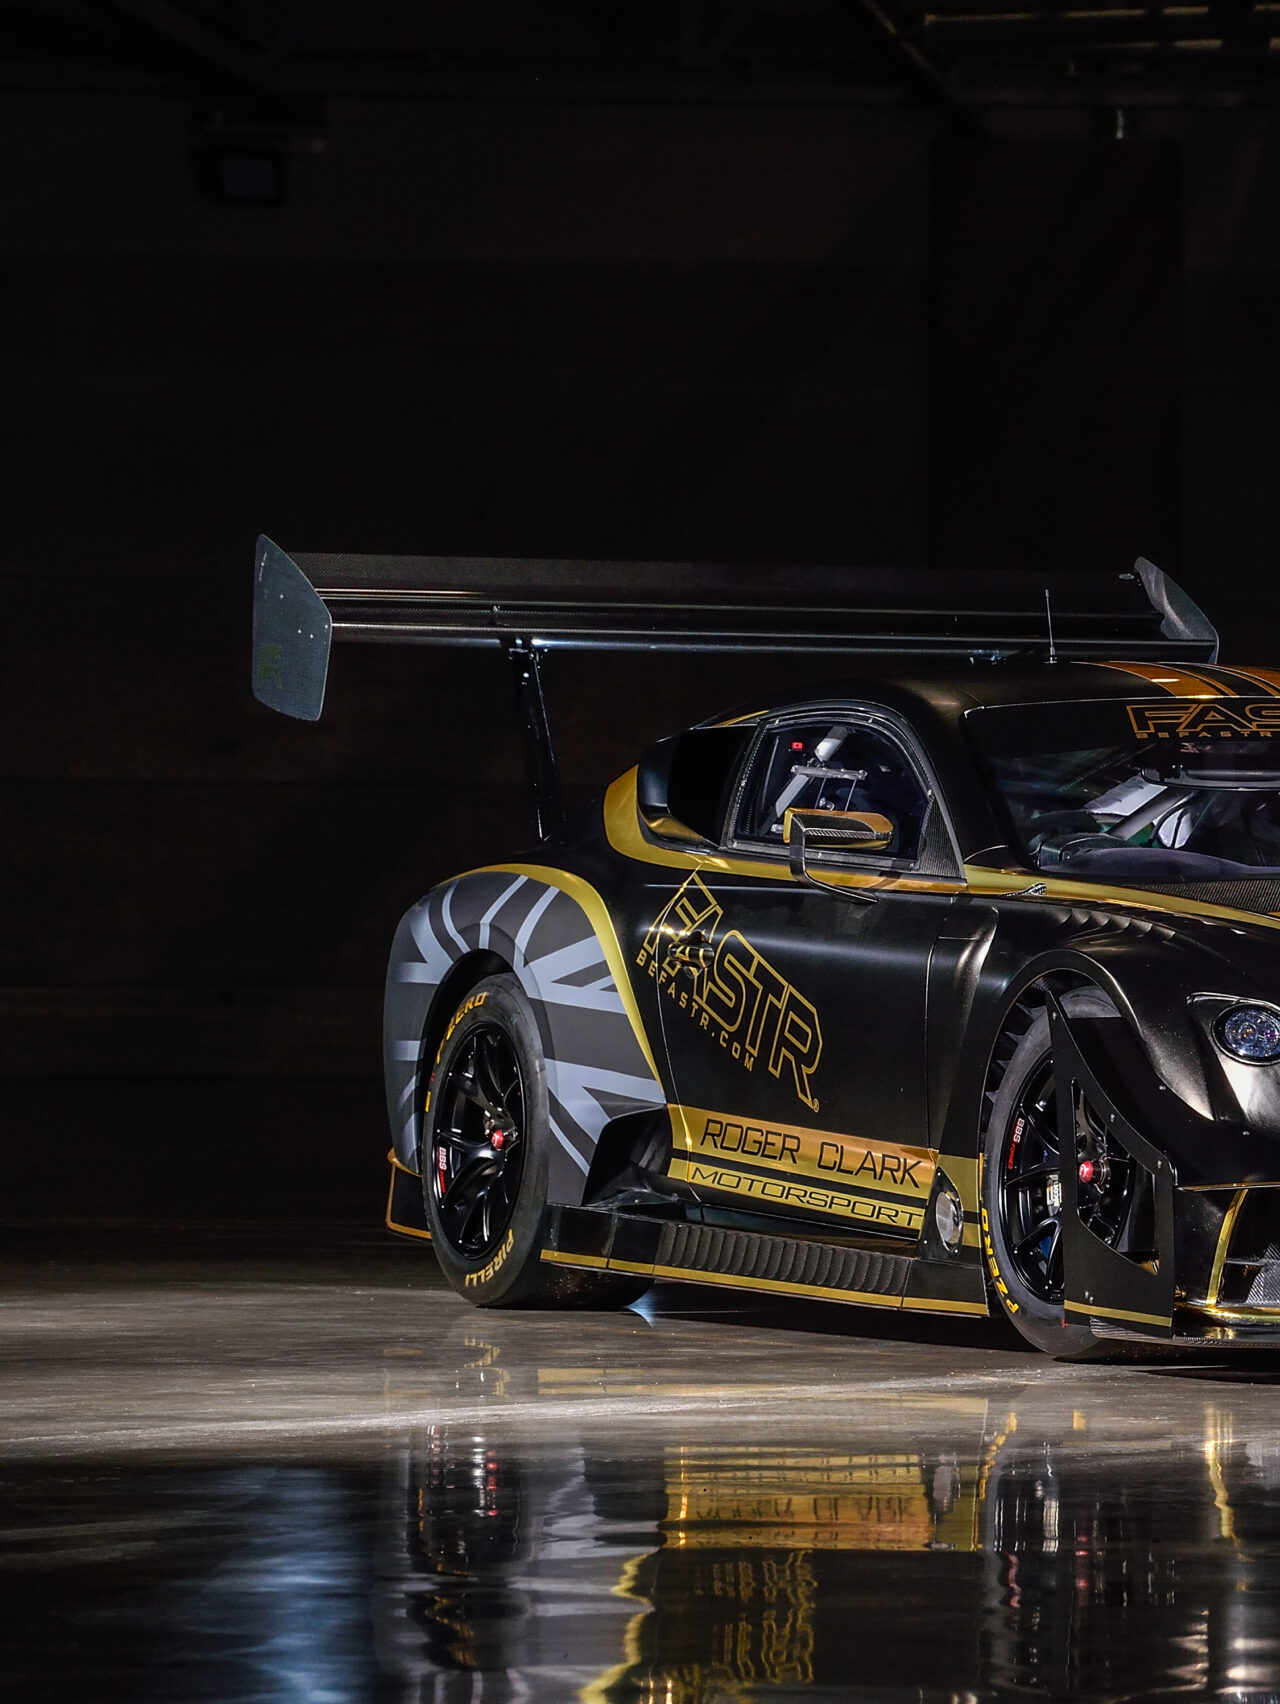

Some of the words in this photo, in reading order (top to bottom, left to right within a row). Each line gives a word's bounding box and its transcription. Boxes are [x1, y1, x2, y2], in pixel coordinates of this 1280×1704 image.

[635, 948, 755, 1072] BEFASTR.COM
[700, 1118, 801, 1165] ROGER
[817, 1140, 923, 1189] CLARK
[1013, 1117, 1025, 1144] BBS
[691, 1166, 925, 1227] MOTORSPORT
[464, 1228, 515, 1288] PIRELLI
